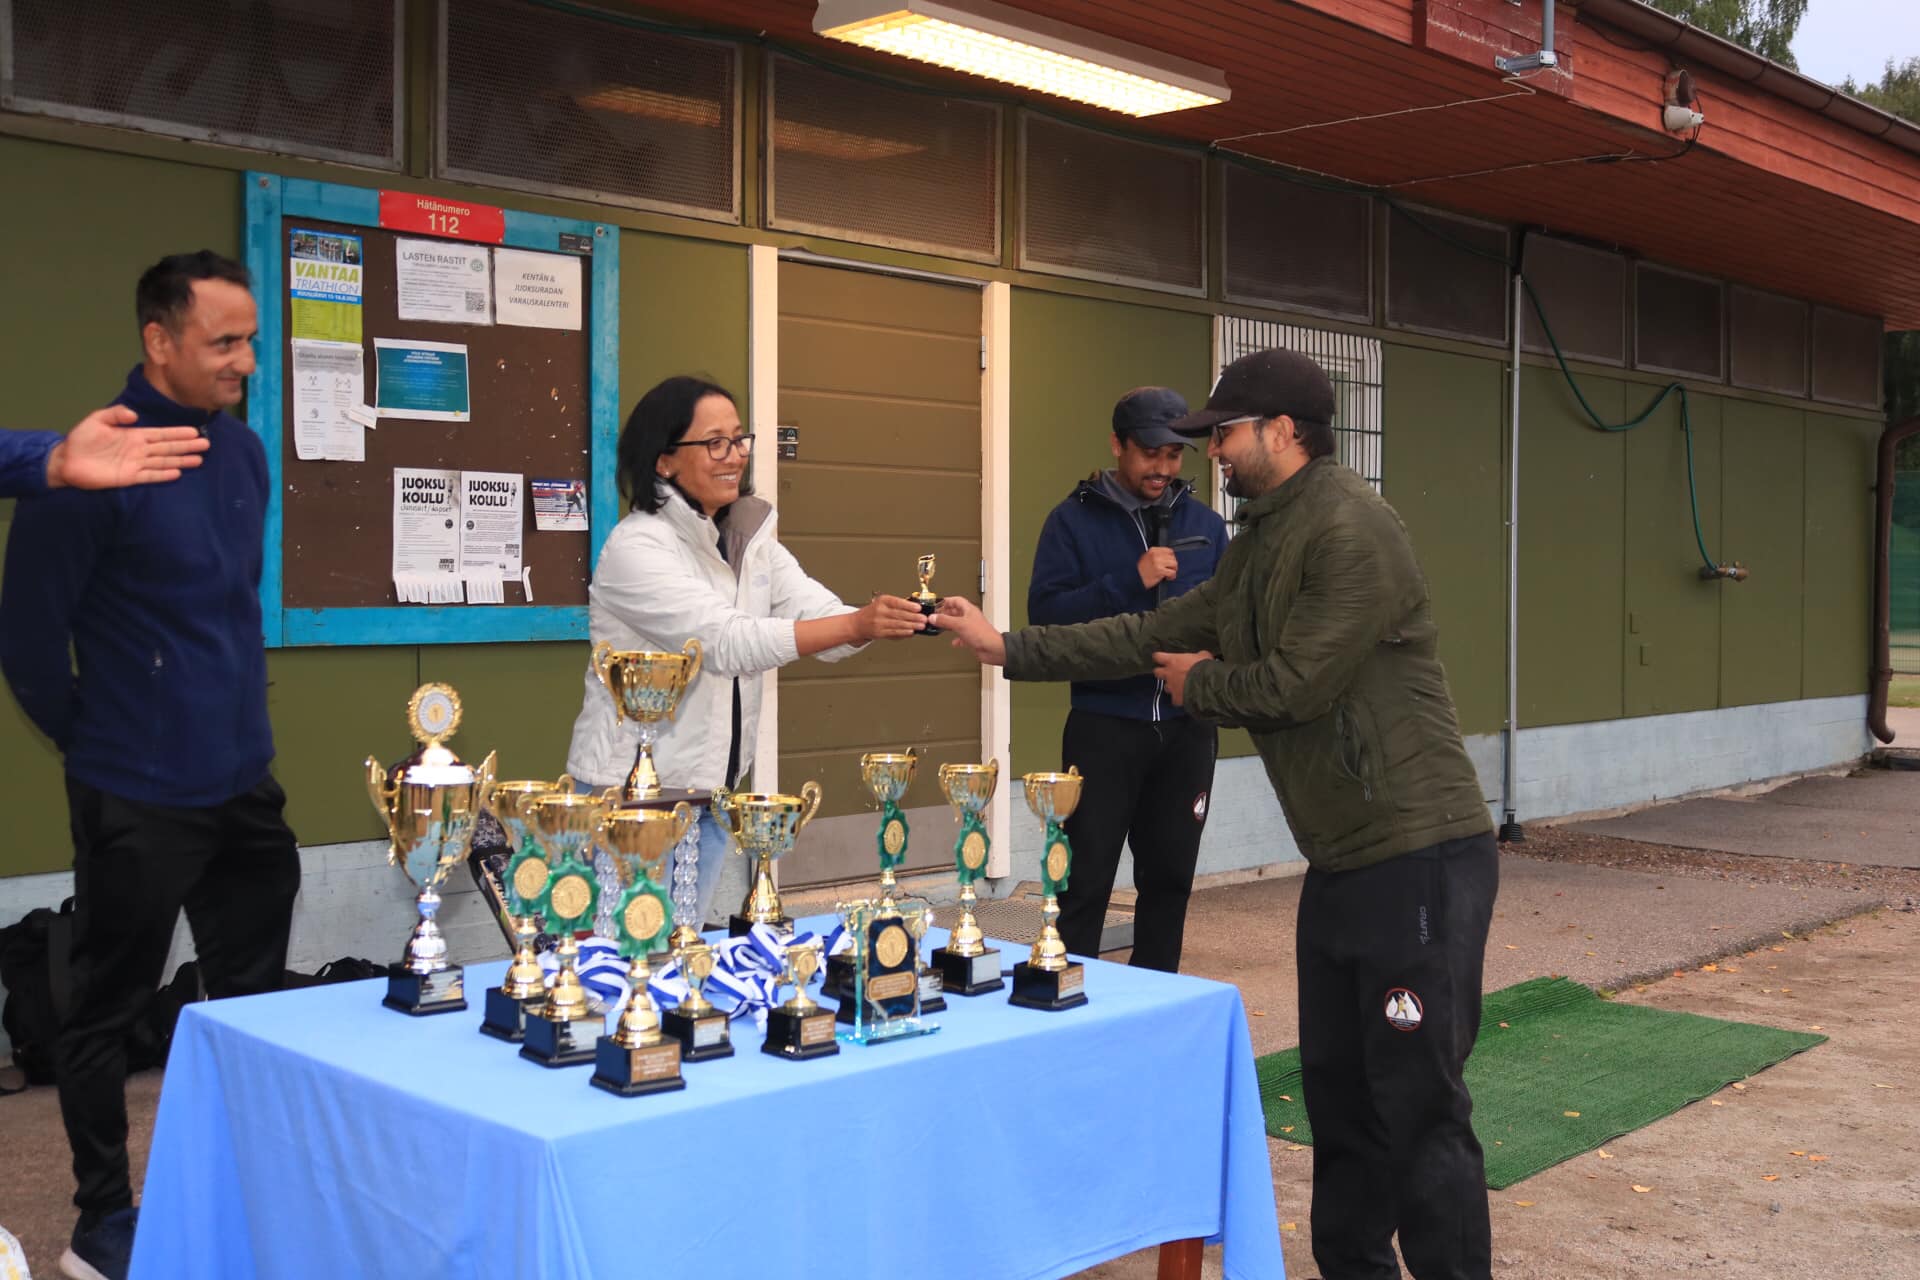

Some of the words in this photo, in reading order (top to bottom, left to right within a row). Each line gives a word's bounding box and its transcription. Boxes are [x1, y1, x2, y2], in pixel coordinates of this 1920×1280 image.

[416, 199, 470, 216] Hätänumero
[428, 213, 459, 234] 112
[402, 252, 436, 262] LASTEN
[438, 255, 466, 265] RASTIT
[295, 261, 359, 283] VANTAA
[522, 272, 549, 283] KENTÄN
[296, 278, 360, 294] TRIATHLON
[514, 284, 563, 295] JUOKSURADAN
[508, 297, 569, 309] VARAUSKALENTERI
[402, 477, 446, 490] JUOKSU
[468, 480, 509, 493] JUOKSU
[402, 492, 444, 504] KOULU
[469, 494, 508, 507] KOULU
[1419, 905, 1429, 937] CRAFT
